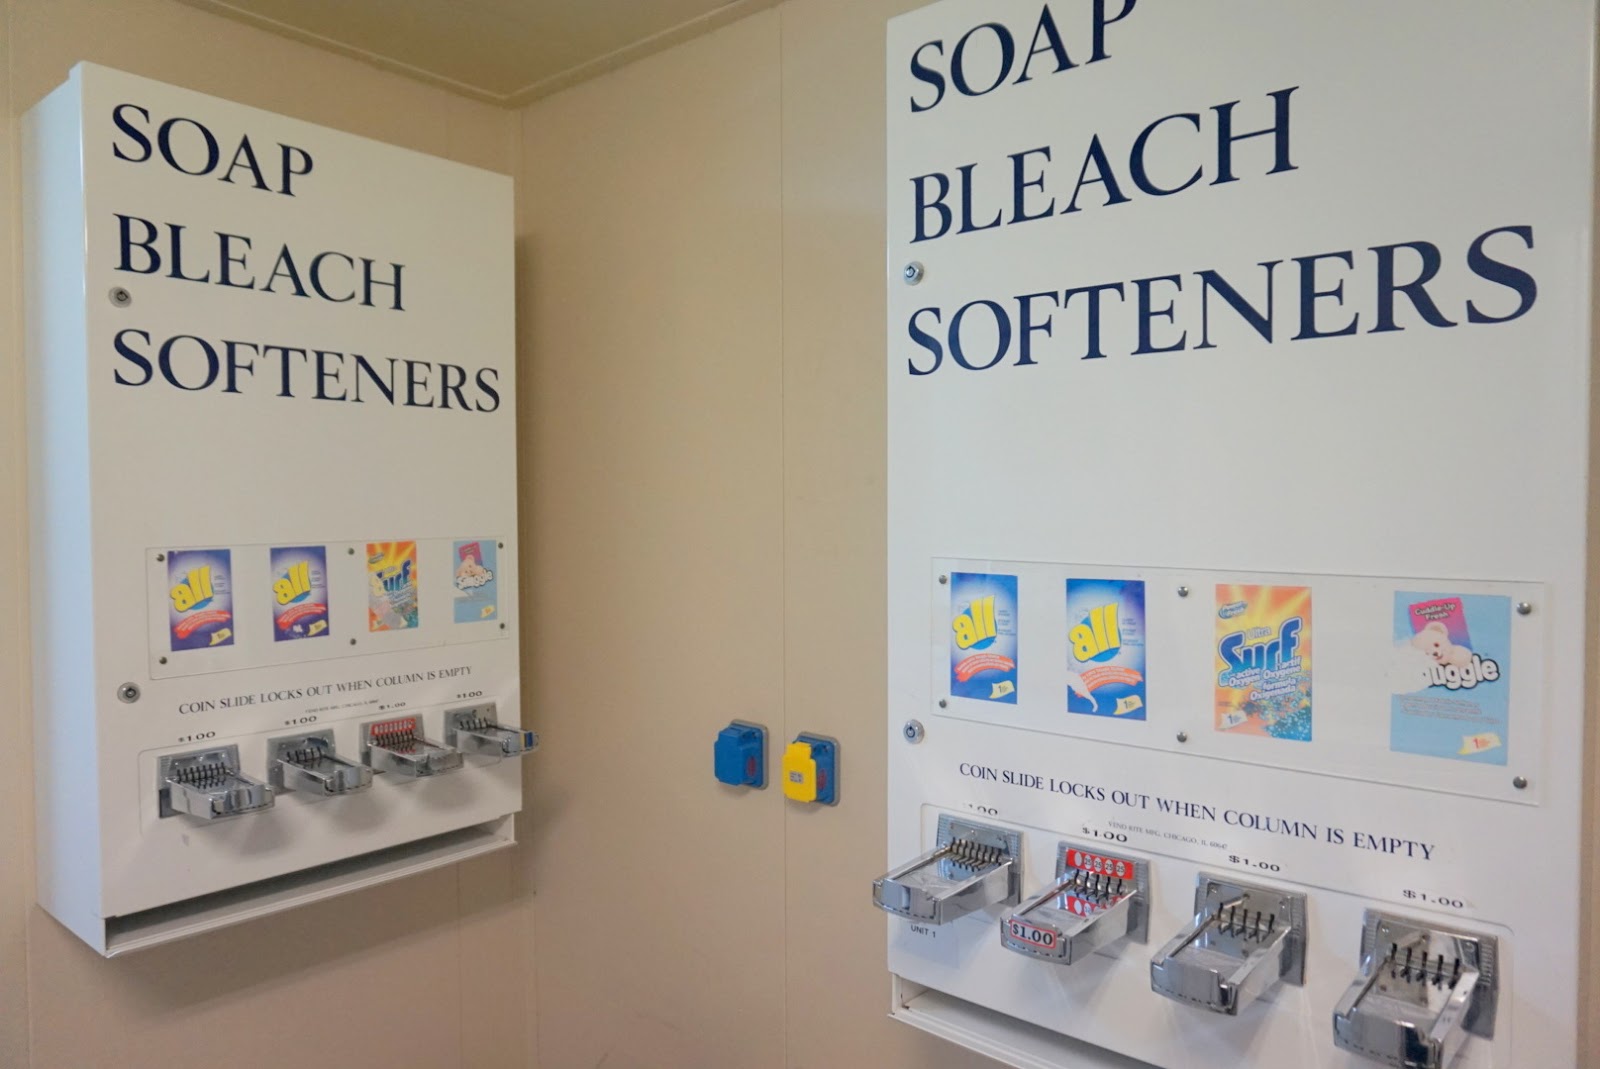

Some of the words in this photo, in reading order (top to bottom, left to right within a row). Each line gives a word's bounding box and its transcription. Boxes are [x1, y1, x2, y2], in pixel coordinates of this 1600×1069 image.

[910, 0, 1137, 113] SOAP
[112, 103, 314, 197] SOAP
[909, 86, 1300, 244] BLEACH
[113, 213, 406, 311] BLEACH
[907, 225, 1538, 376] SOFTENERS
[113, 328, 500, 413] SOFTENERS
[170, 565, 214, 613] all
[272, 561, 312, 605] all
[952, 595, 997, 650] all
[1069, 602, 1121, 662] all
[1218, 617, 1303, 688] Surf
[1421, 652, 1500, 691] uggle
[178, 700, 215, 715] COIN
[220, 694, 256, 709] SLIDE
[260, 688, 302, 704] LOCKS
[306, 684, 333, 697] OUT
[336, 679, 373, 693] WHEN
[375, 672, 425, 689] COLUMN
[427, 671, 436, 681] IS
[439, 666, 472, 679] EMPTY
[959, 762, 998, 782] COIN
[1002, 770, 1044, 790] SLIDE
[1049, 778, 1106, 802] LOCKS
[1111, 789, 1150, 810] OUT
[1156, 796, 1217, 823] WHEN
[1223, 809, 1318, 841] COLUMN
[1326, 827, 1345, 845] IS
[1353, 831, 1435, 861] EMPTY
[1082, 827, 1128, 843] $1.00
[1228, 855, 1281, 873] $1.00
[1402, 888, 1464, 909] $1.00
[911, 924, 929, 935] UNIT
[1011, 923, 1054, 946] $1.00
